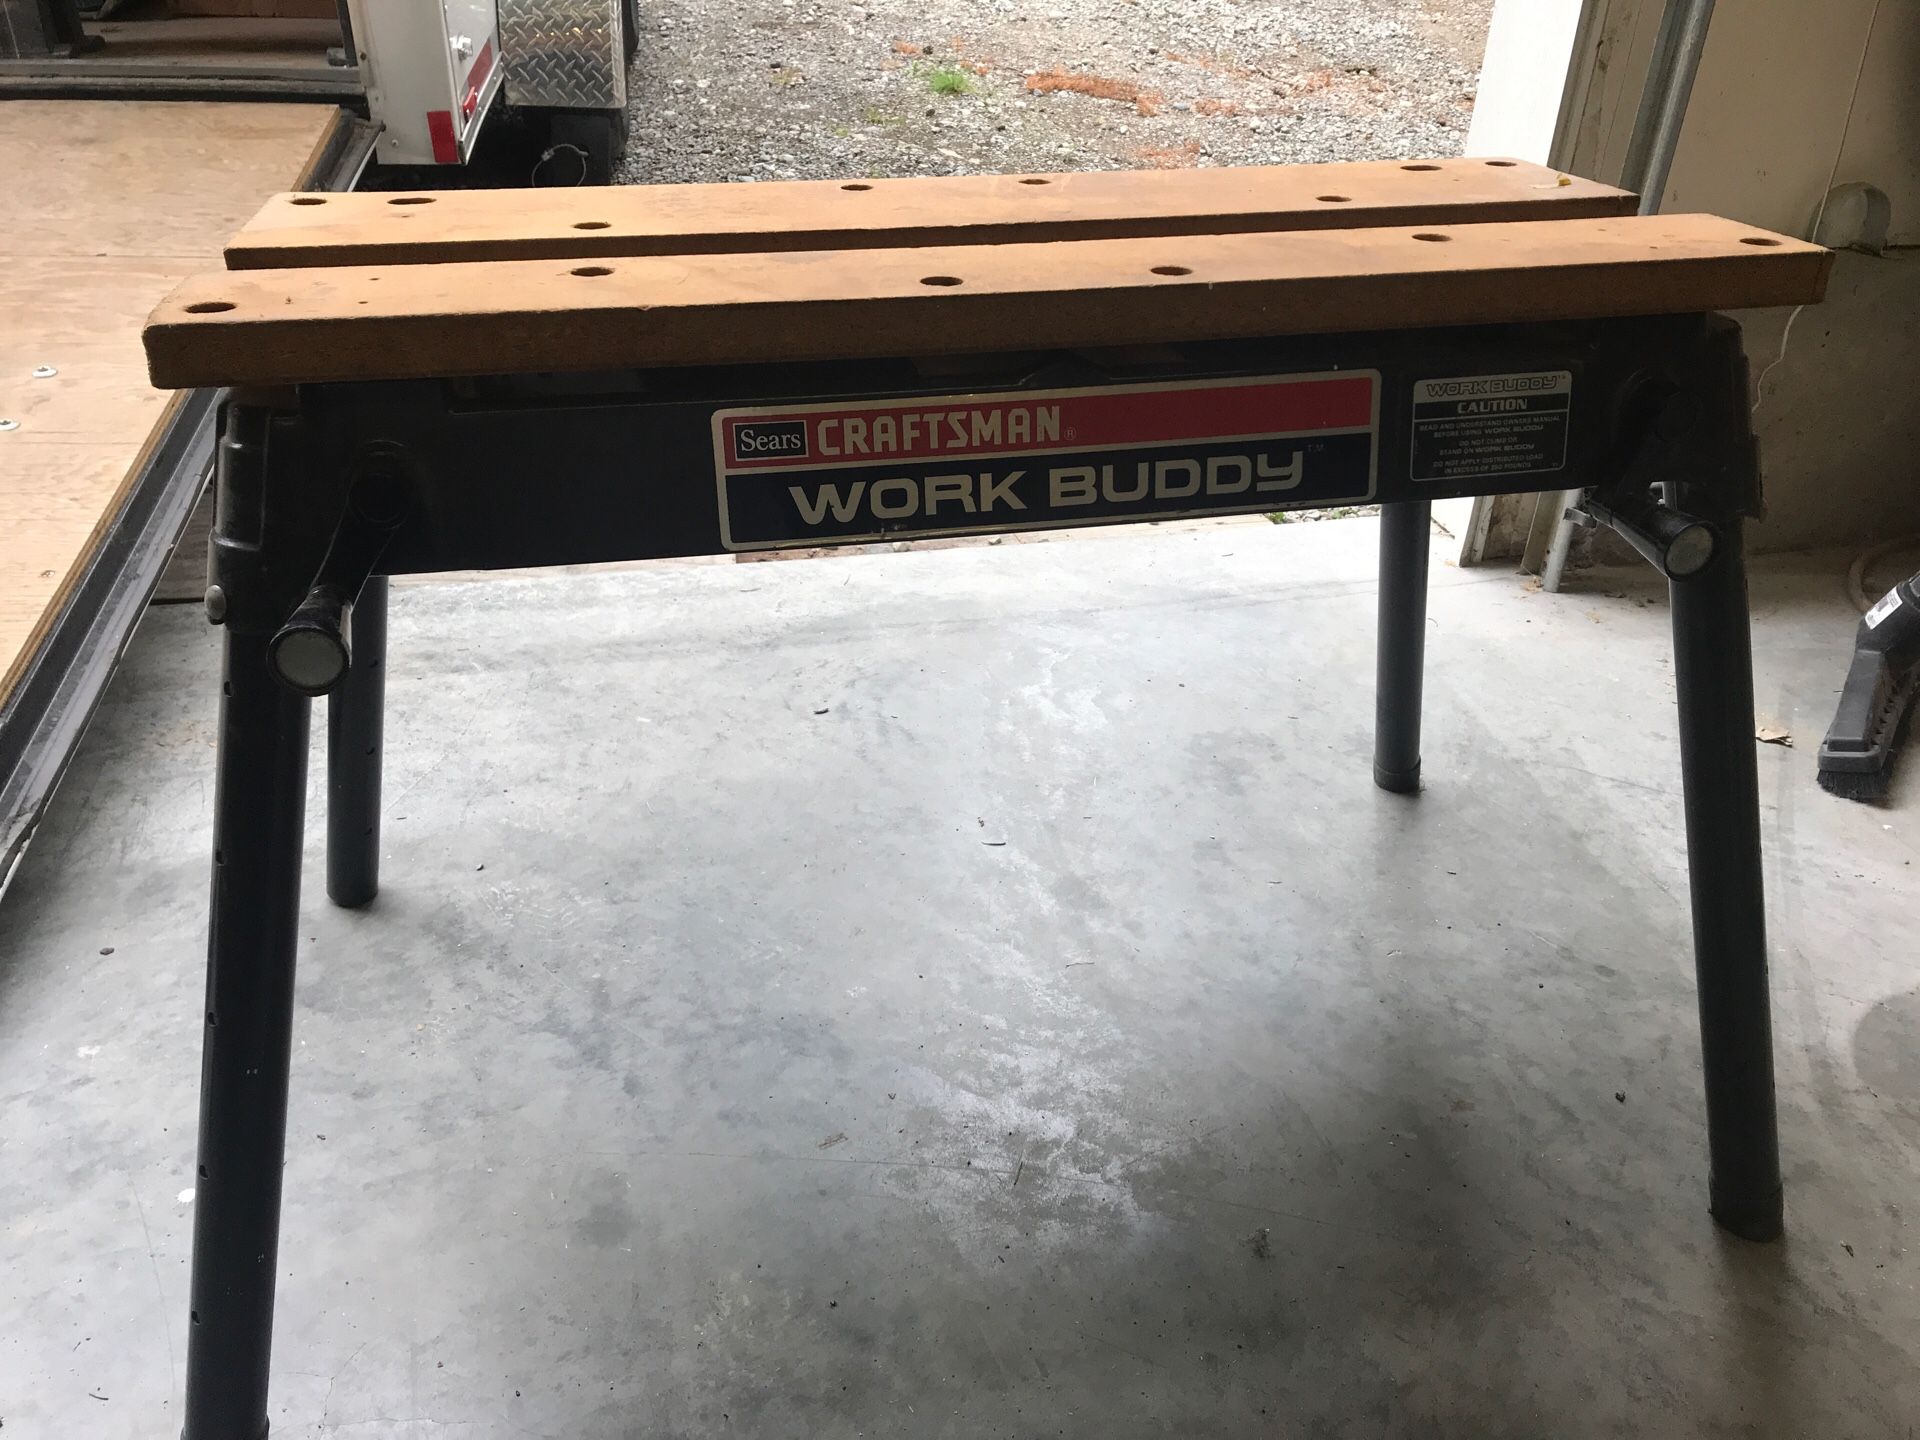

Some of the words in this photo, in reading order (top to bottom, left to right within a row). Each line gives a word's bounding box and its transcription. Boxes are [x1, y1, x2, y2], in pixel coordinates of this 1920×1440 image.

[1427, 381, 1489, 396] WORK
[1490, 376, 1557, 393] BUDDY
[1457, 399, 1528, 414] CAUTION
[740, 429, 802, 452] Sears
[817, 405, 1060, 456] CRAFTSMAN
[1476, 445, 1502, 453] WORK
[788, 470, 1028, 525] WORK
[1049, 451, 1303, 507] BUDDY
